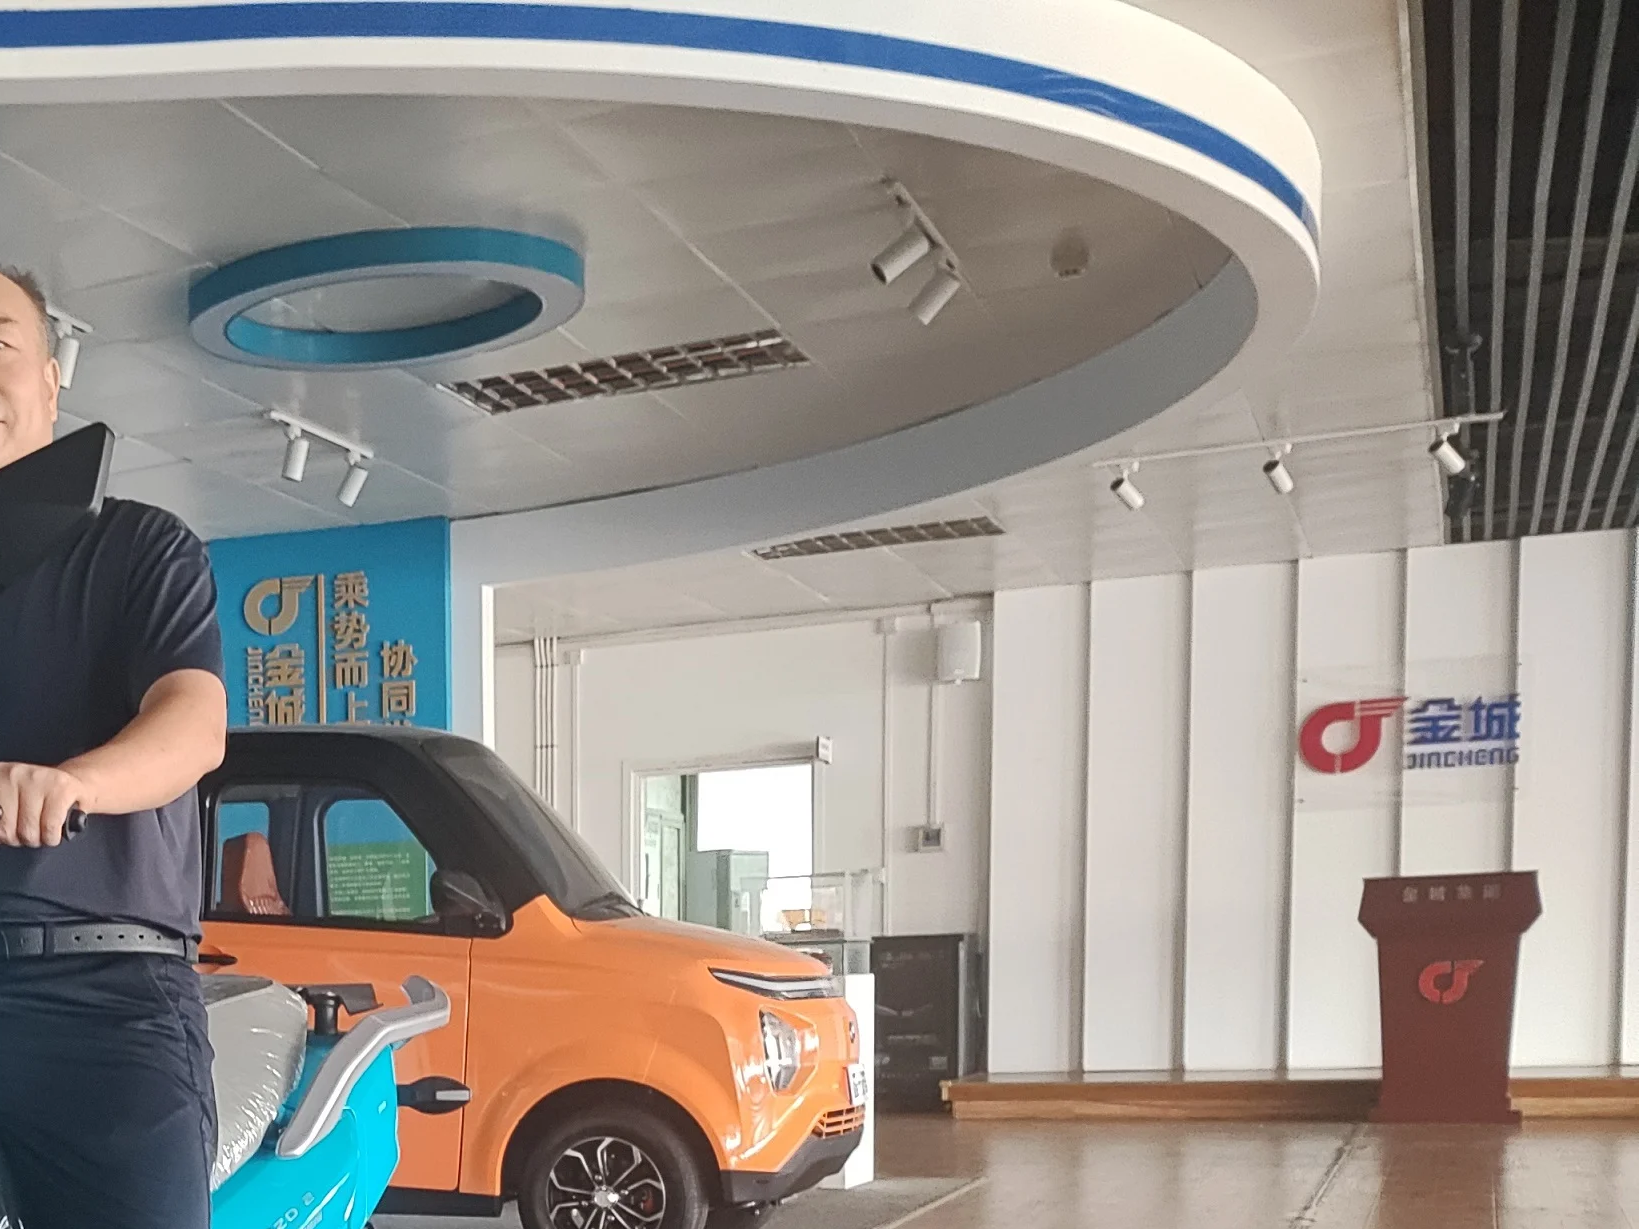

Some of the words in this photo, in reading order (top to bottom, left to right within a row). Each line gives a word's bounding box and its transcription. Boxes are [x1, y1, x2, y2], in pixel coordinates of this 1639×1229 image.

[333, 571, 369, 725] 乘势而上
[380, 640, 418, 727] 协同
[1407, 693, 1522, 745] 金城
[1406, 747, 1520, 769] JINCHENG
